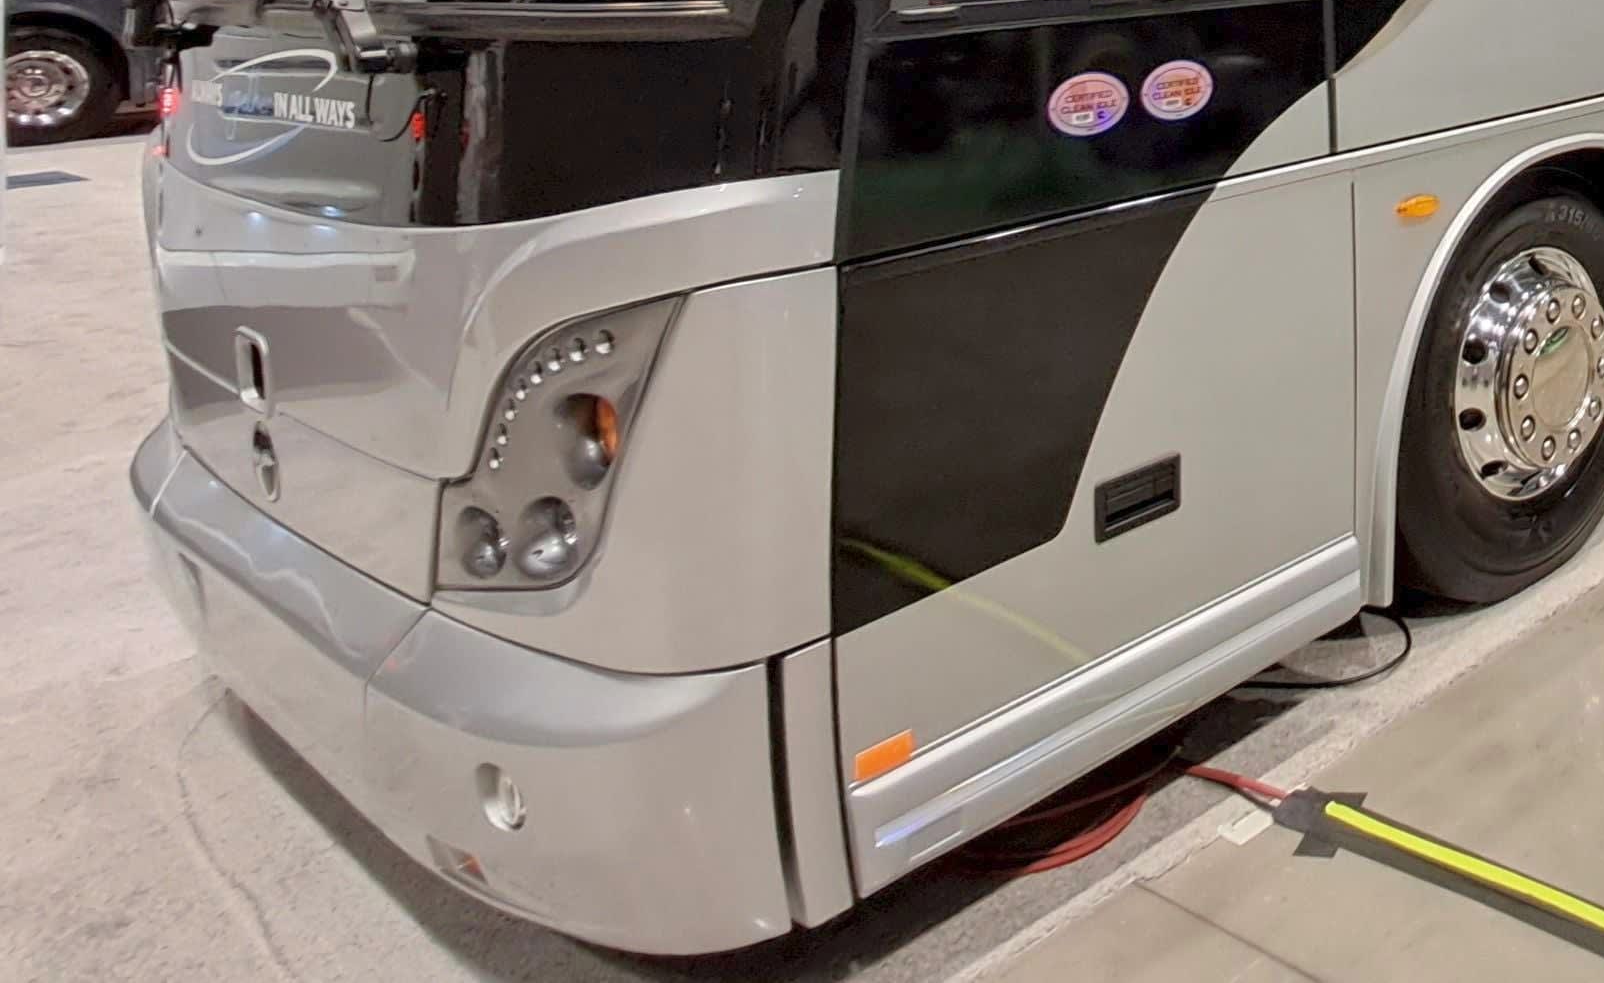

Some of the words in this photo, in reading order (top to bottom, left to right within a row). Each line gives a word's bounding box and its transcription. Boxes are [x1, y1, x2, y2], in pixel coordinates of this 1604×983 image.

[273, 92, 289, 118] IN
[289, 94, 314, 122] ALL
[313, 97, 356, 130] WAYS
